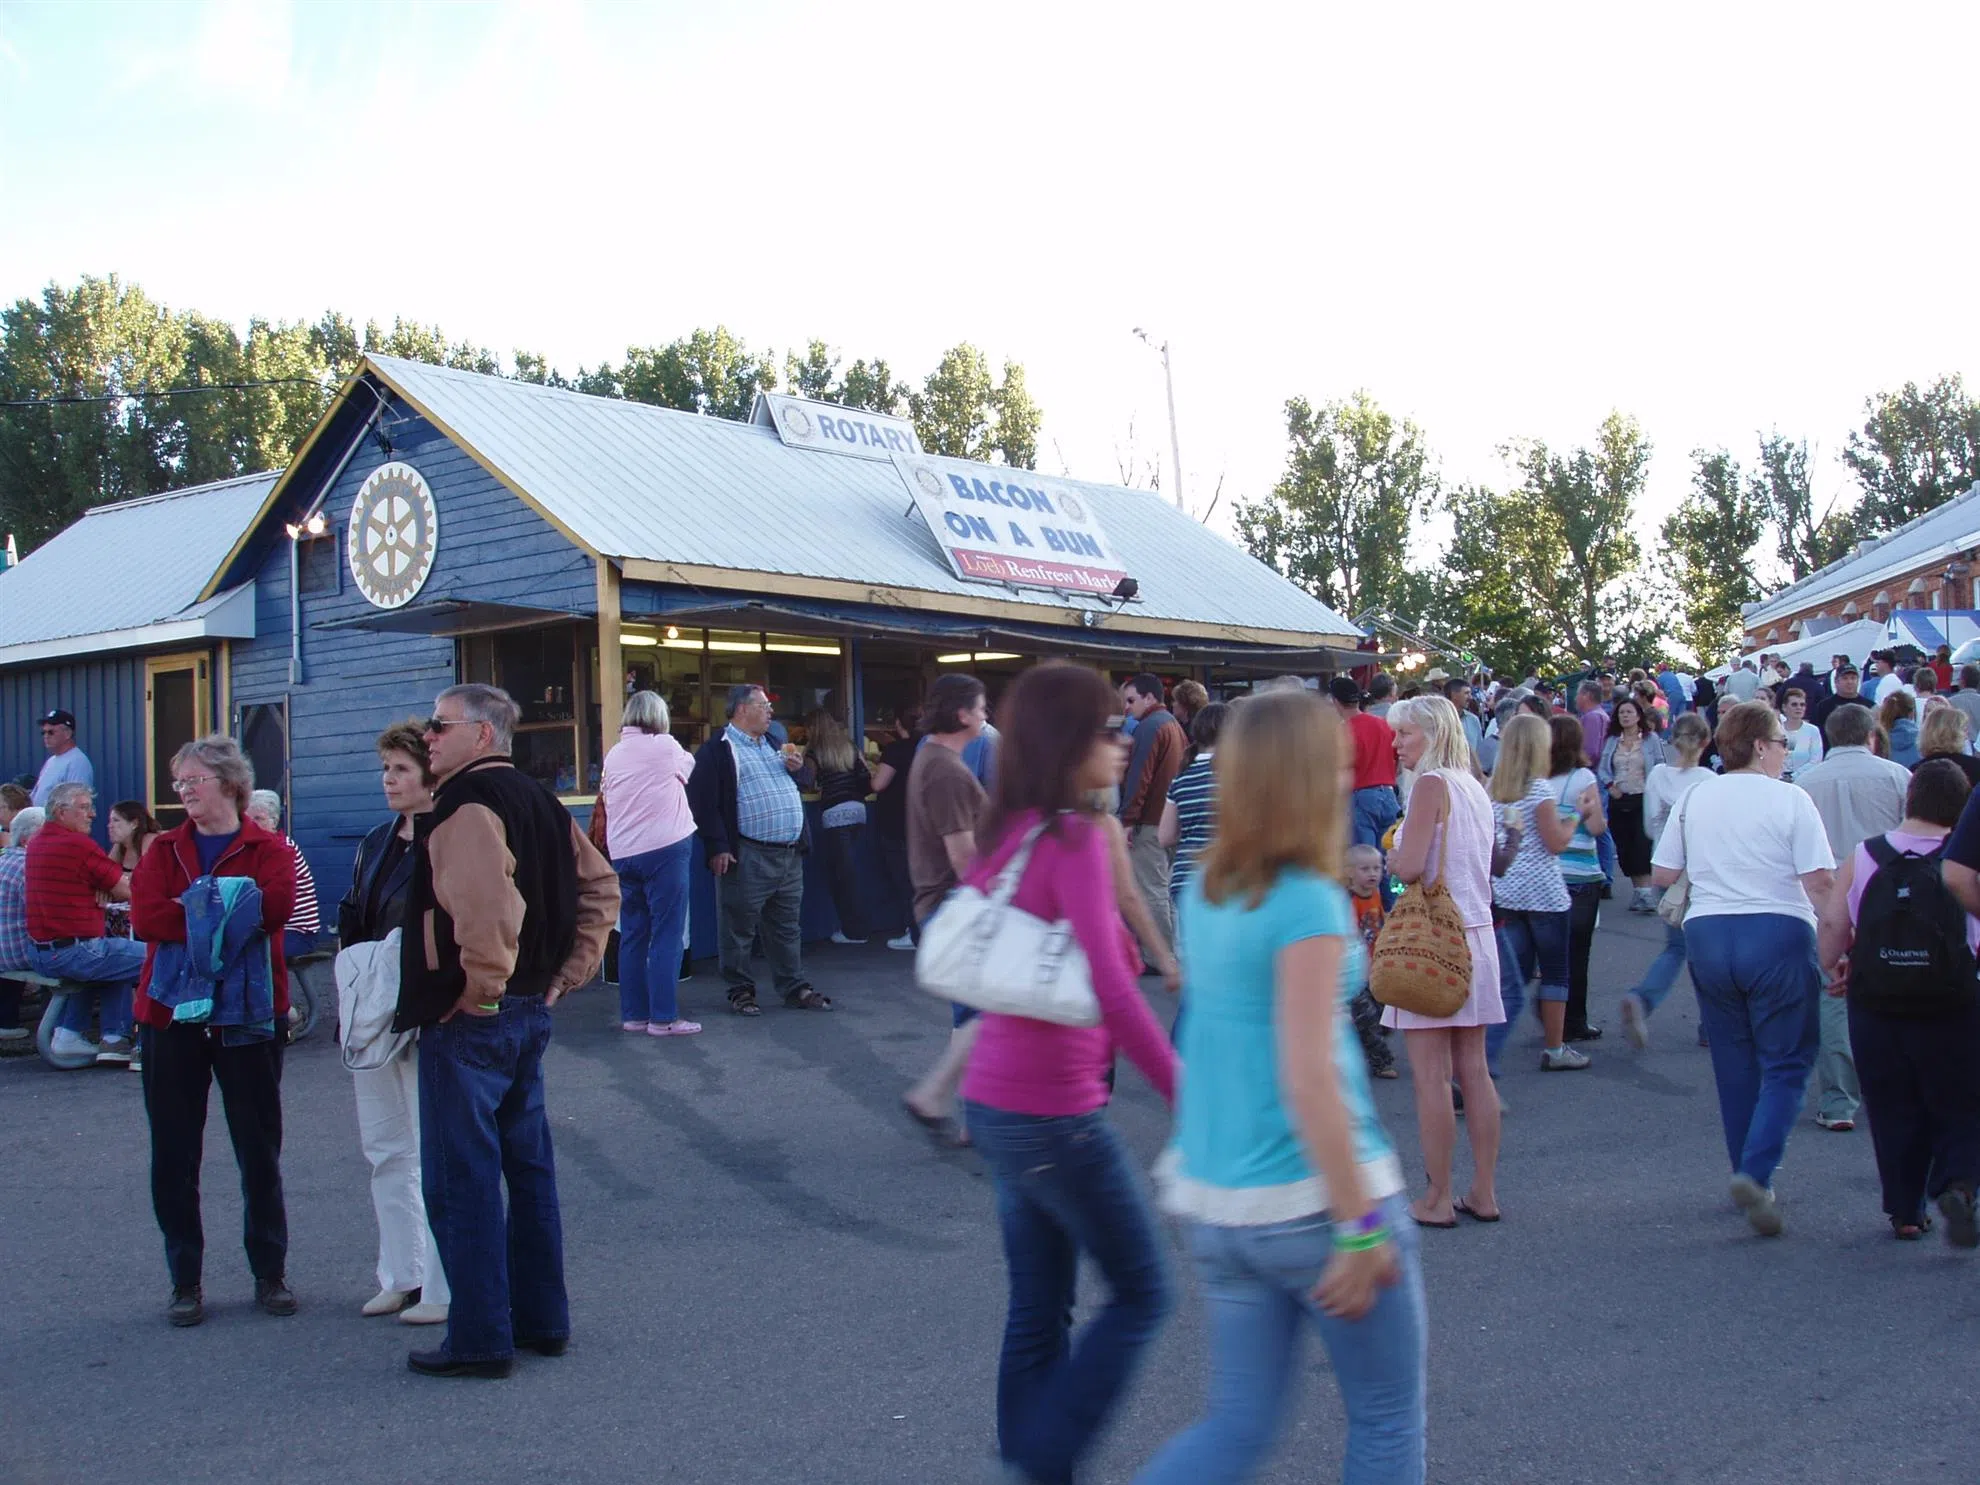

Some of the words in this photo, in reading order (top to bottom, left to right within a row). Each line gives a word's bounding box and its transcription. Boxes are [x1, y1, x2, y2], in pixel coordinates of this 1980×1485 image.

[817, 414, 916, 454] ROTARY
[947, 473, 1056, 514] BACON
[944, 511, 998, 543] ON
[1008, 521, 1034, 547] A
[1040, 526, 1104, 558] BUN
[1005, 560, 1074, 584] Renfrew
